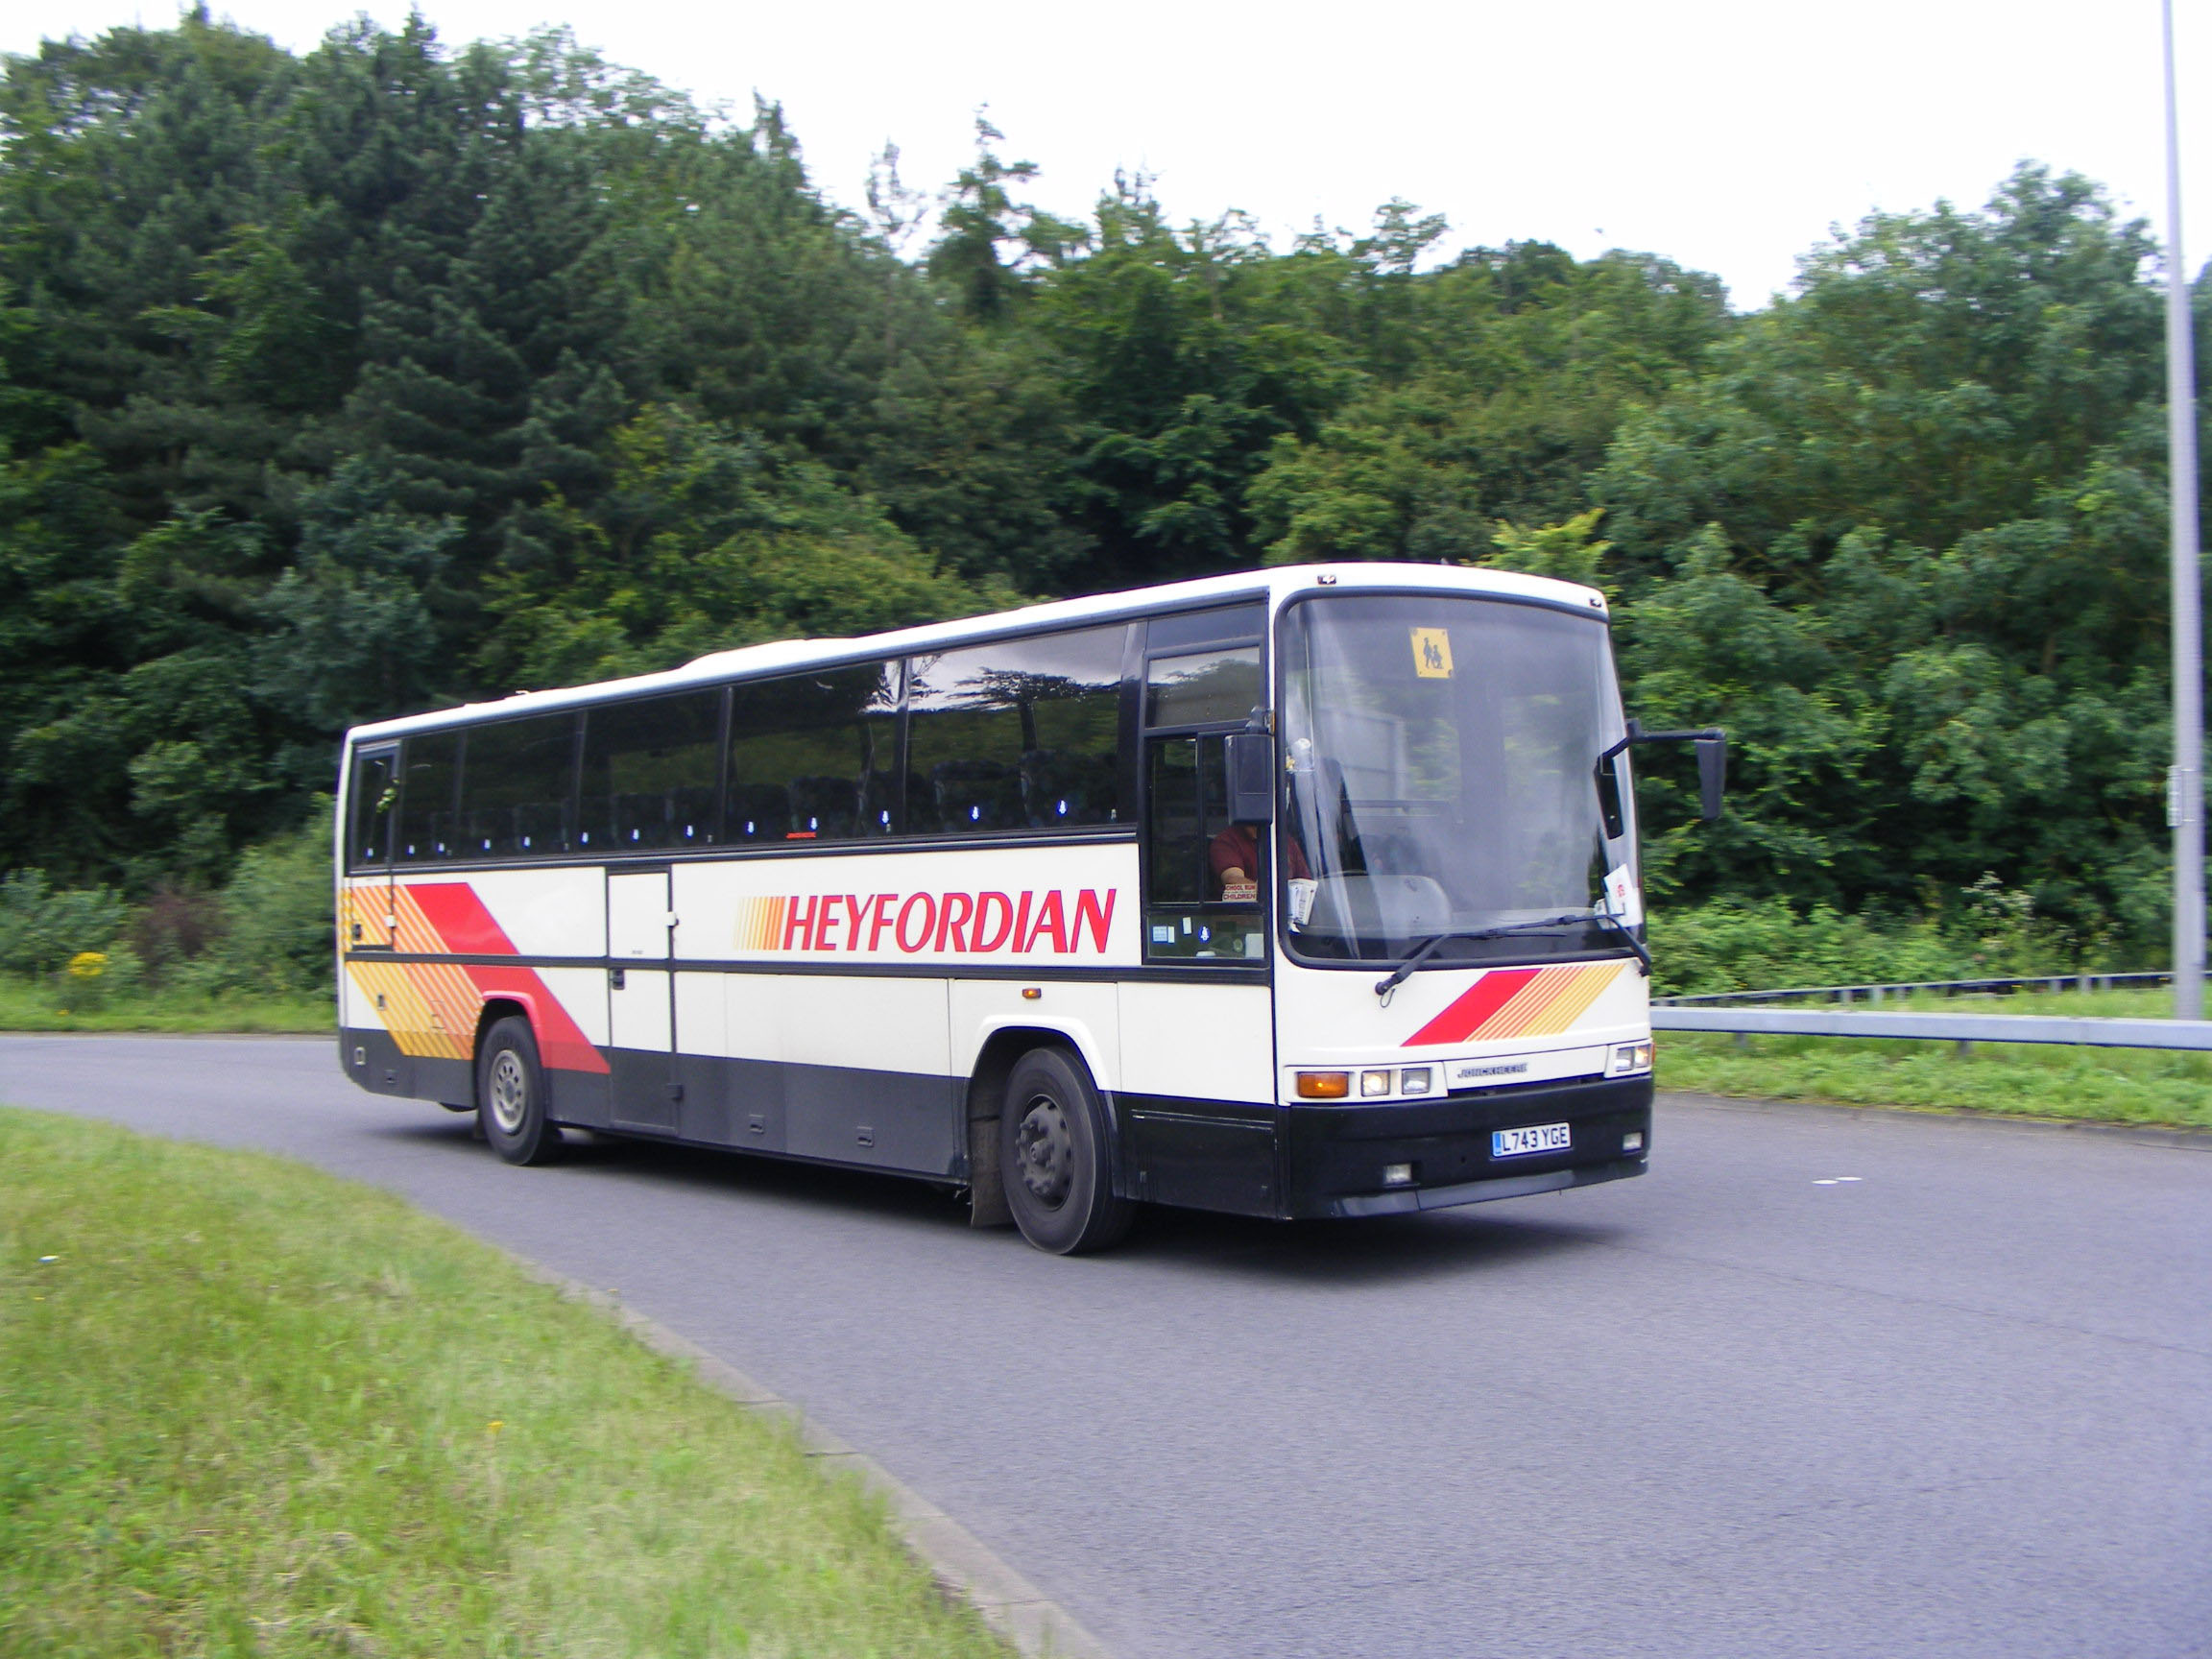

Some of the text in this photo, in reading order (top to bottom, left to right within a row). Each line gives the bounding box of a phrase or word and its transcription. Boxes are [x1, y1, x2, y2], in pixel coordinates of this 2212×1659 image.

[782, 888, 1117, 953] HEYFORDIAN
[1502, 1126, 1567, 1151] L743 YGE
